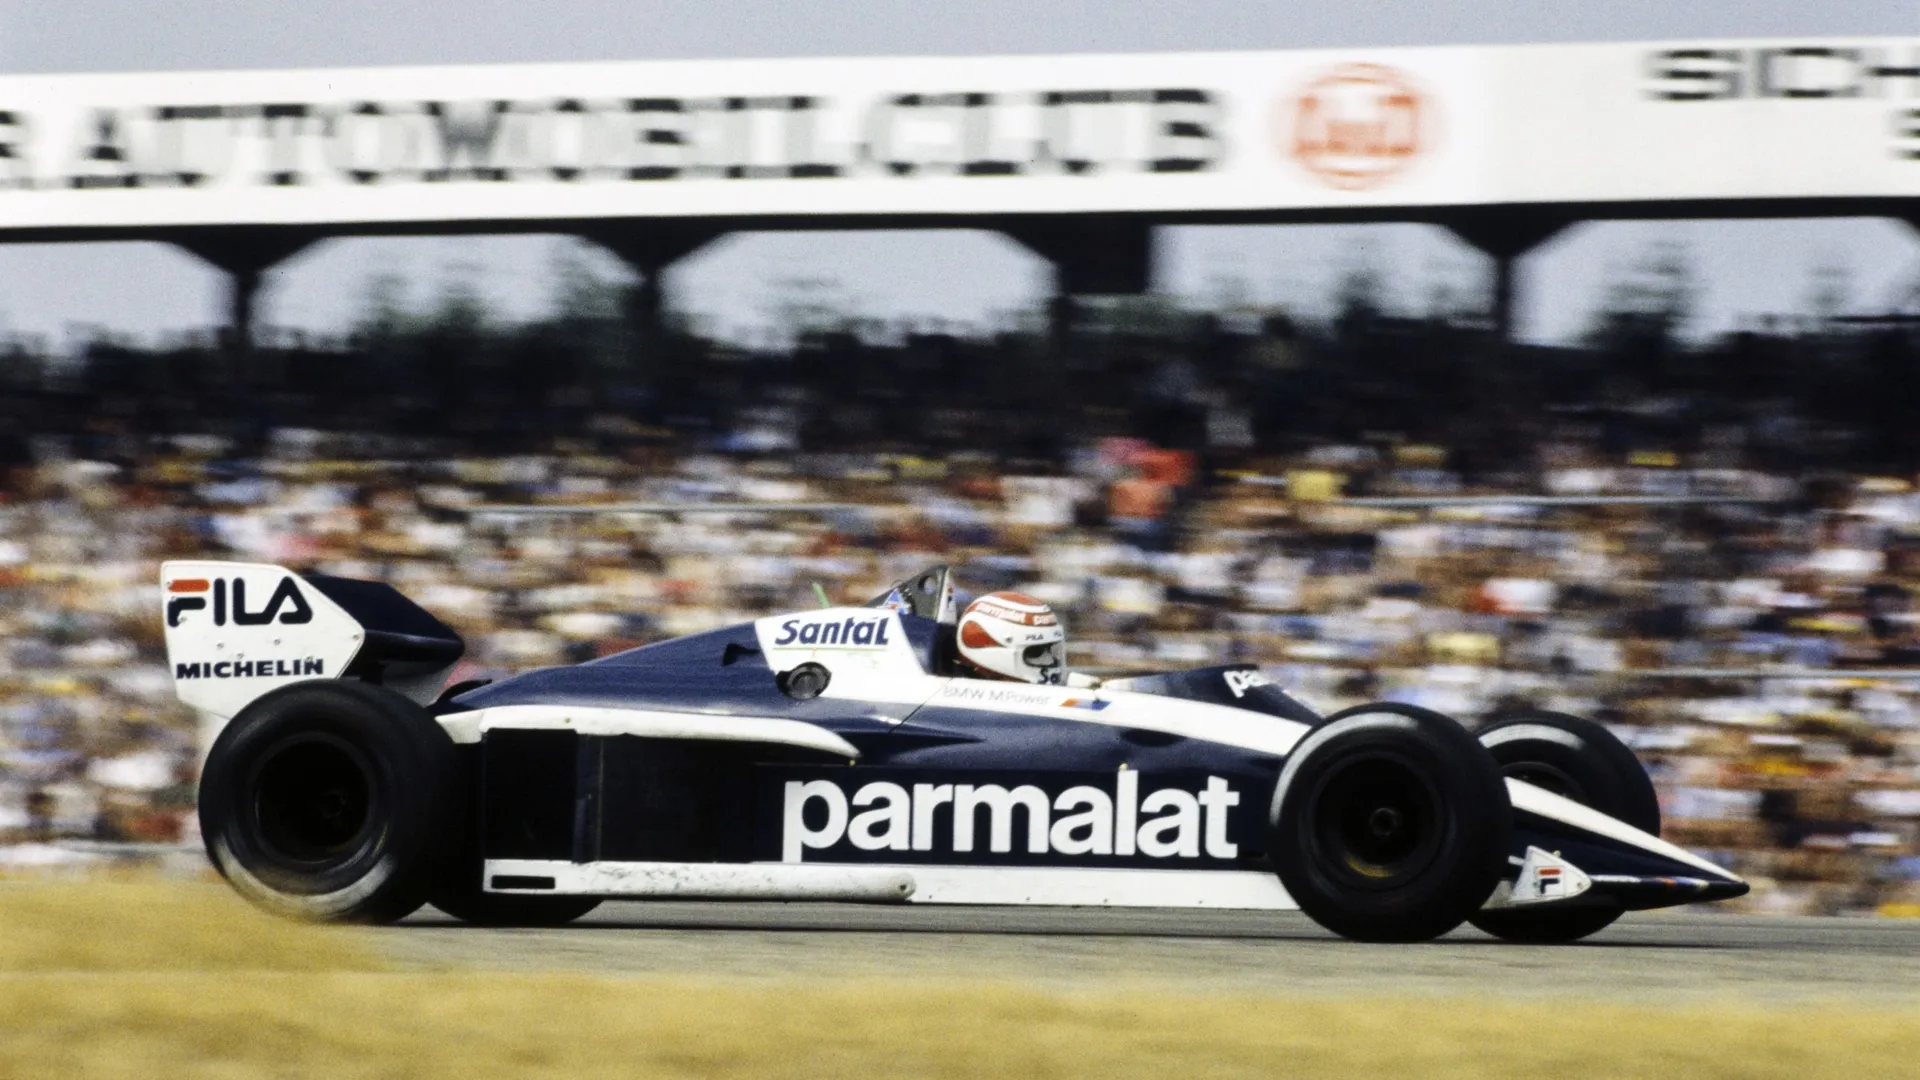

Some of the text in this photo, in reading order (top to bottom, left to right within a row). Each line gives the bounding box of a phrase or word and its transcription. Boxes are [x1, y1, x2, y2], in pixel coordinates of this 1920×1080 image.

[167, 575, 313, 627] FILA
[1025, 633, 1044, 641] FILA
[176, 658, 324, 680] MICHELIN
[943, 686, 985, 700] BMW
[782, 769, 1241, 863] parmalat
